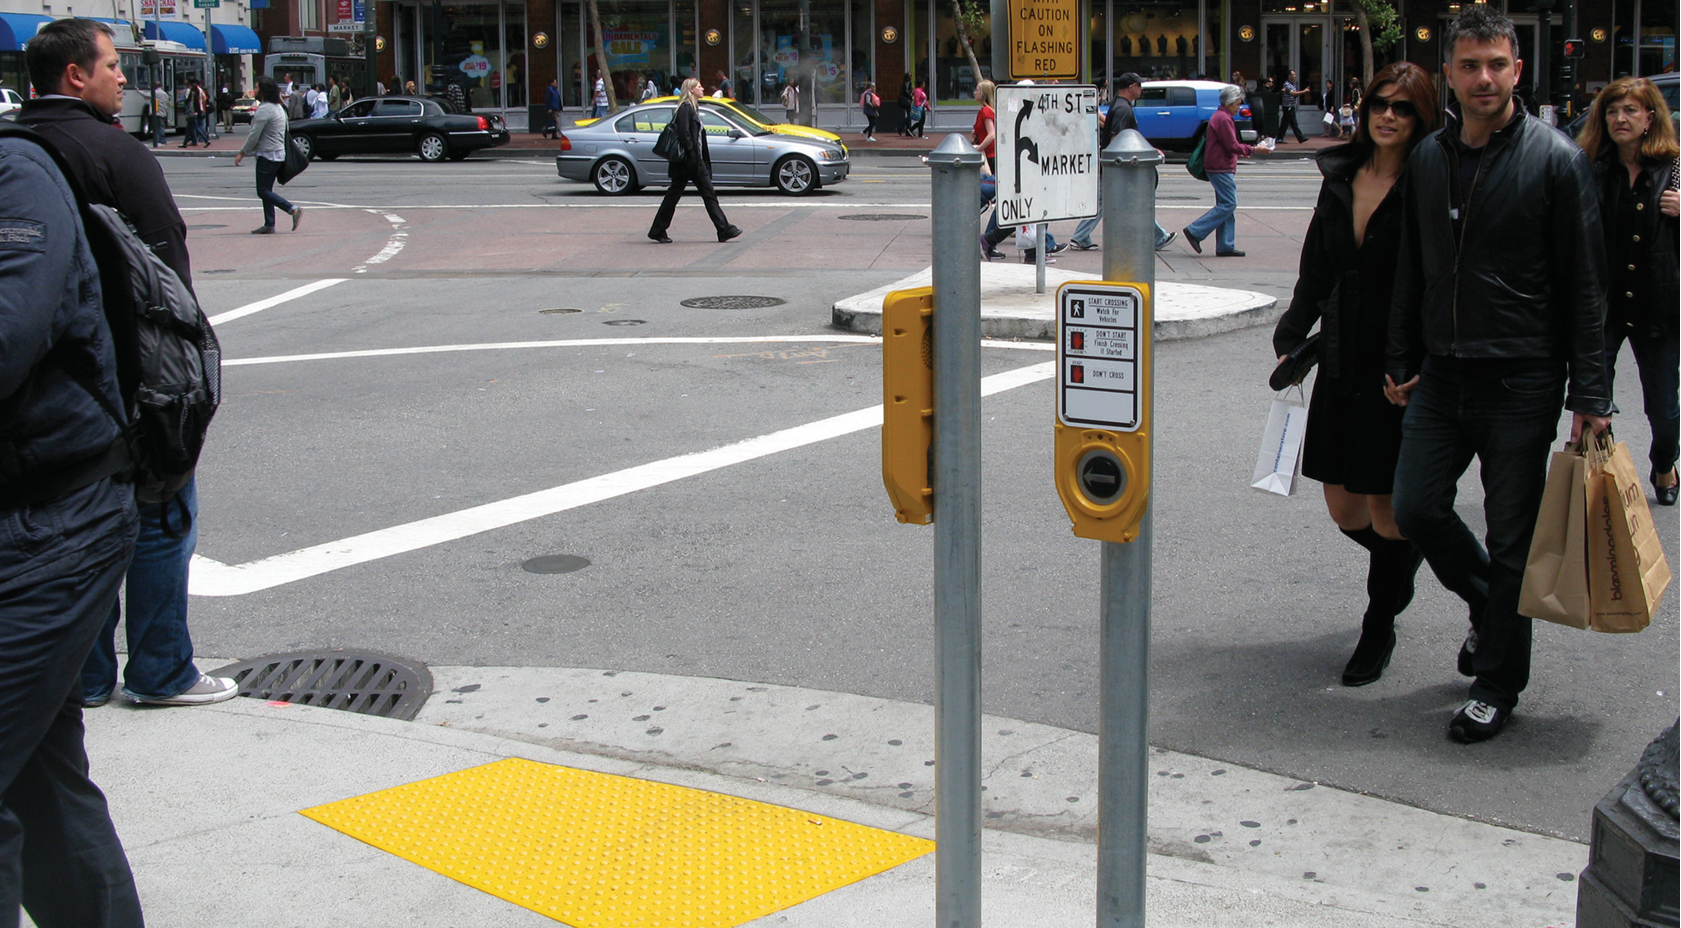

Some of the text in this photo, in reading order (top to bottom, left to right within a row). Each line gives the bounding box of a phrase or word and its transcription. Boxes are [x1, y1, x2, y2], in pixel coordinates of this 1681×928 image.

[1020, 7, 1069, 21] CAUTION
[602, 32, 658, 40] UNDAMENTALS
[1038, 24, 1053, 37] ON
[611, 41, 642, 54] SALE
[1016, 41, 1073, 54] FLASHING
[476, 61, 487, 70] $19
[1035, 58, 1056, 71] RED
[1037, 93, 1082, 114] 4TH ST
[1041, 153, 1092, 176] MARKET
[1001, 197, 1033, 220] ONLY
[1104, 298, 1128, 307] CROSSING
[1099, 315, 1117, 323] Vehicles
[1096, 330, 1126, 339] DON'T START
[1094, 339, 1128, 350] Finish Crossing
[1092, 370, 1124, 379] DON'T CROSS
[1273, 413, 1291, 473] containerstore.com
